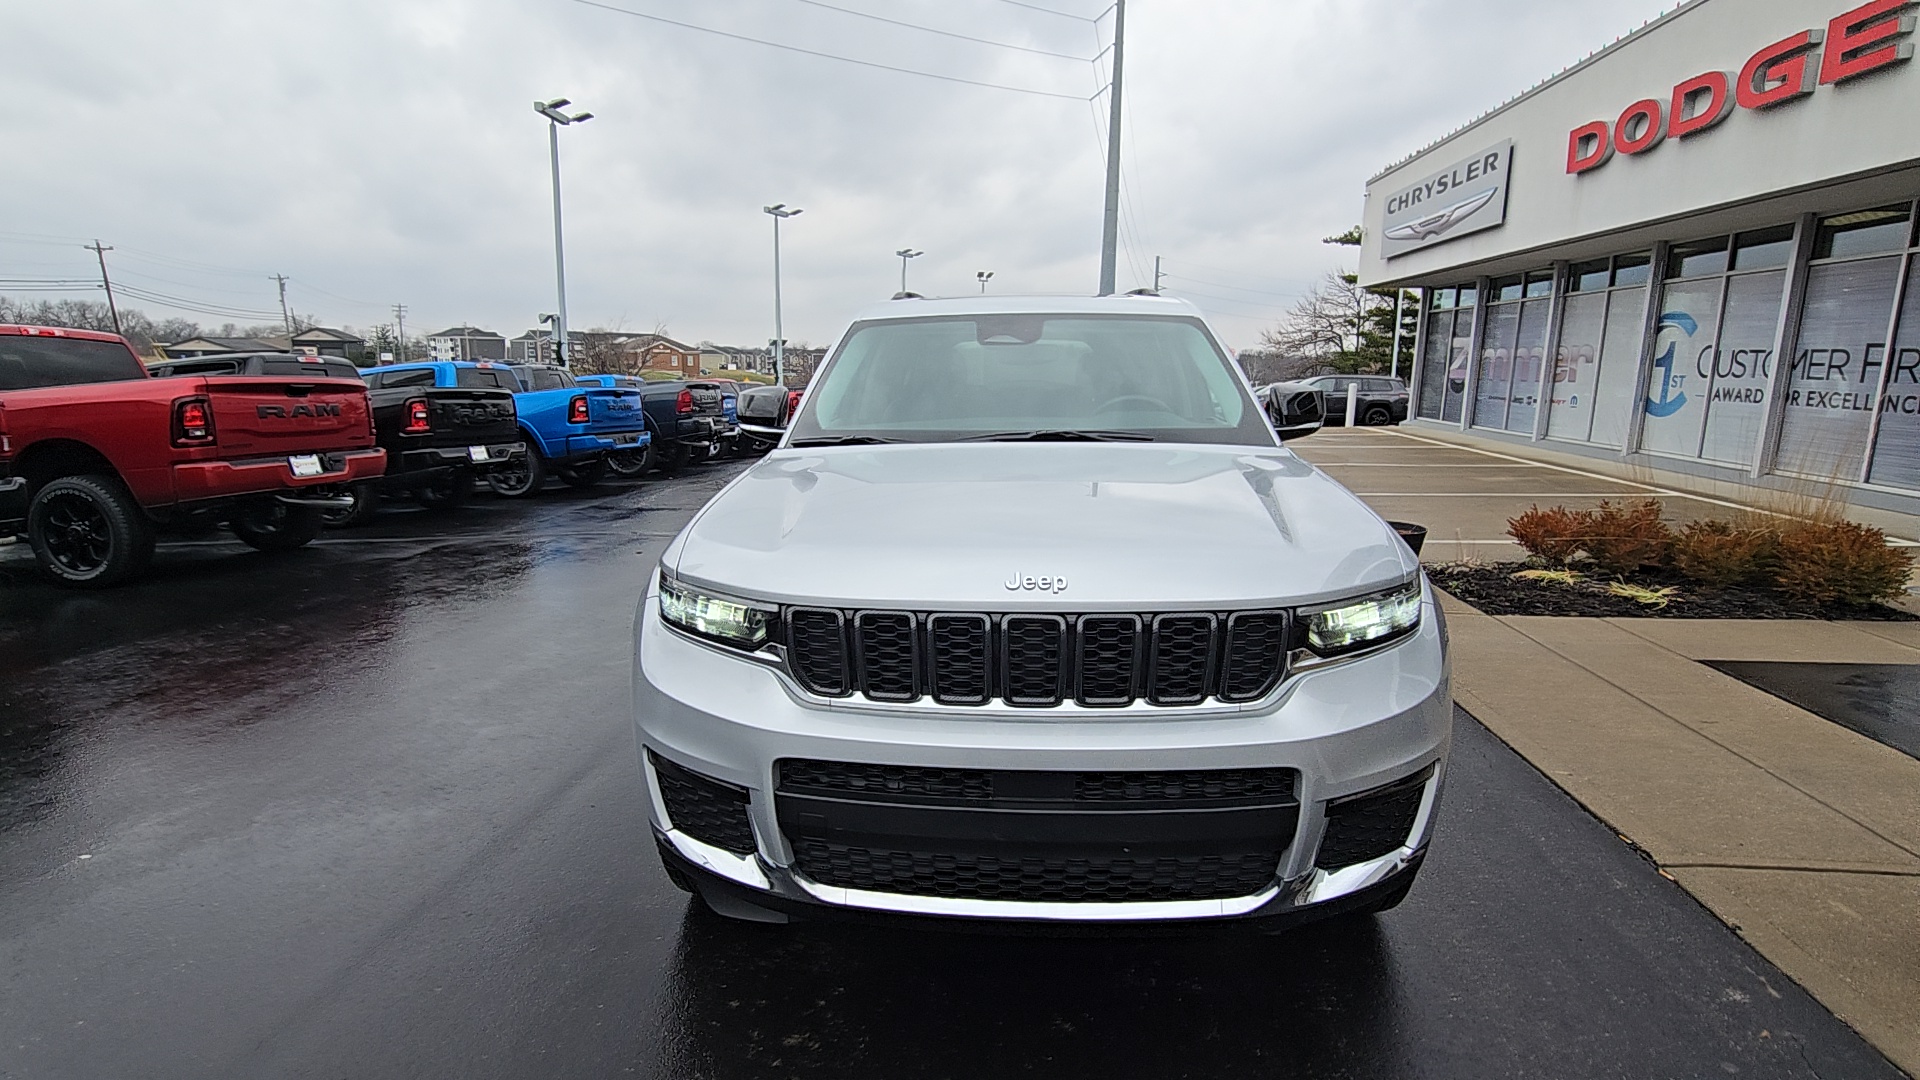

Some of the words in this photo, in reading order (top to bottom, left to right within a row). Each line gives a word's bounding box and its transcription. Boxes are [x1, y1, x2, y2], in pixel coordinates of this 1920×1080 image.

[1566, 0, 1918, 174] DODGE
[1388, 152, 1499, 215] CHRYSLER
[1449, 337, 1594, 383] Zmmer
[1859, 343, 1920, 383] FIR
[257, 404, 341, 419] RAM
[1712, 387, 1764, 404] AWARD
[1806, 391, 1920, 414] EXCELLNC
[1004, 571, 1068, 594] Jeep
